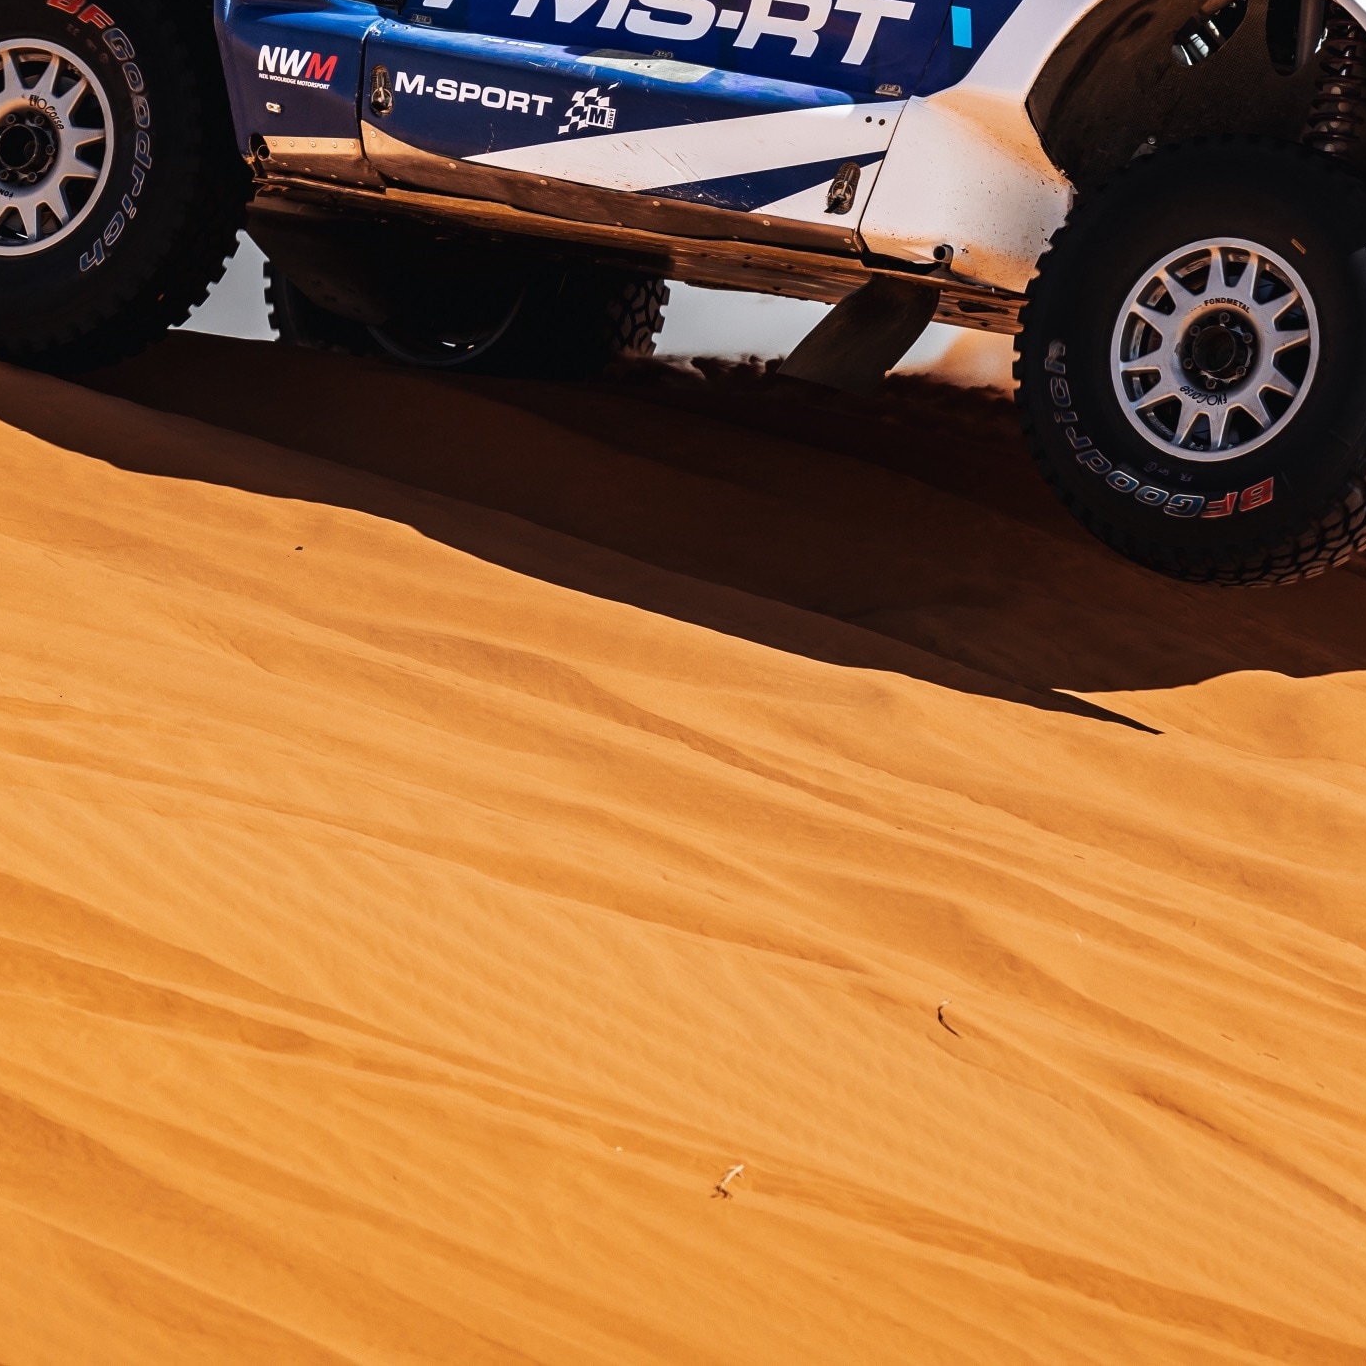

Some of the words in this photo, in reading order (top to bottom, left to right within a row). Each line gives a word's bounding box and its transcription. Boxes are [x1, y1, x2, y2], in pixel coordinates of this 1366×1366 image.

[257, 44, 338, 82] NWM
[297, 79, 331, 90] MOTORSPORT
[394, 71, 553, 116] M-SPORT
[588, 106, 607, 125] M
[1204, 297, 1251, 313] FONDMETAL
[1044, 339, 1275, 519] BFGoodrich
